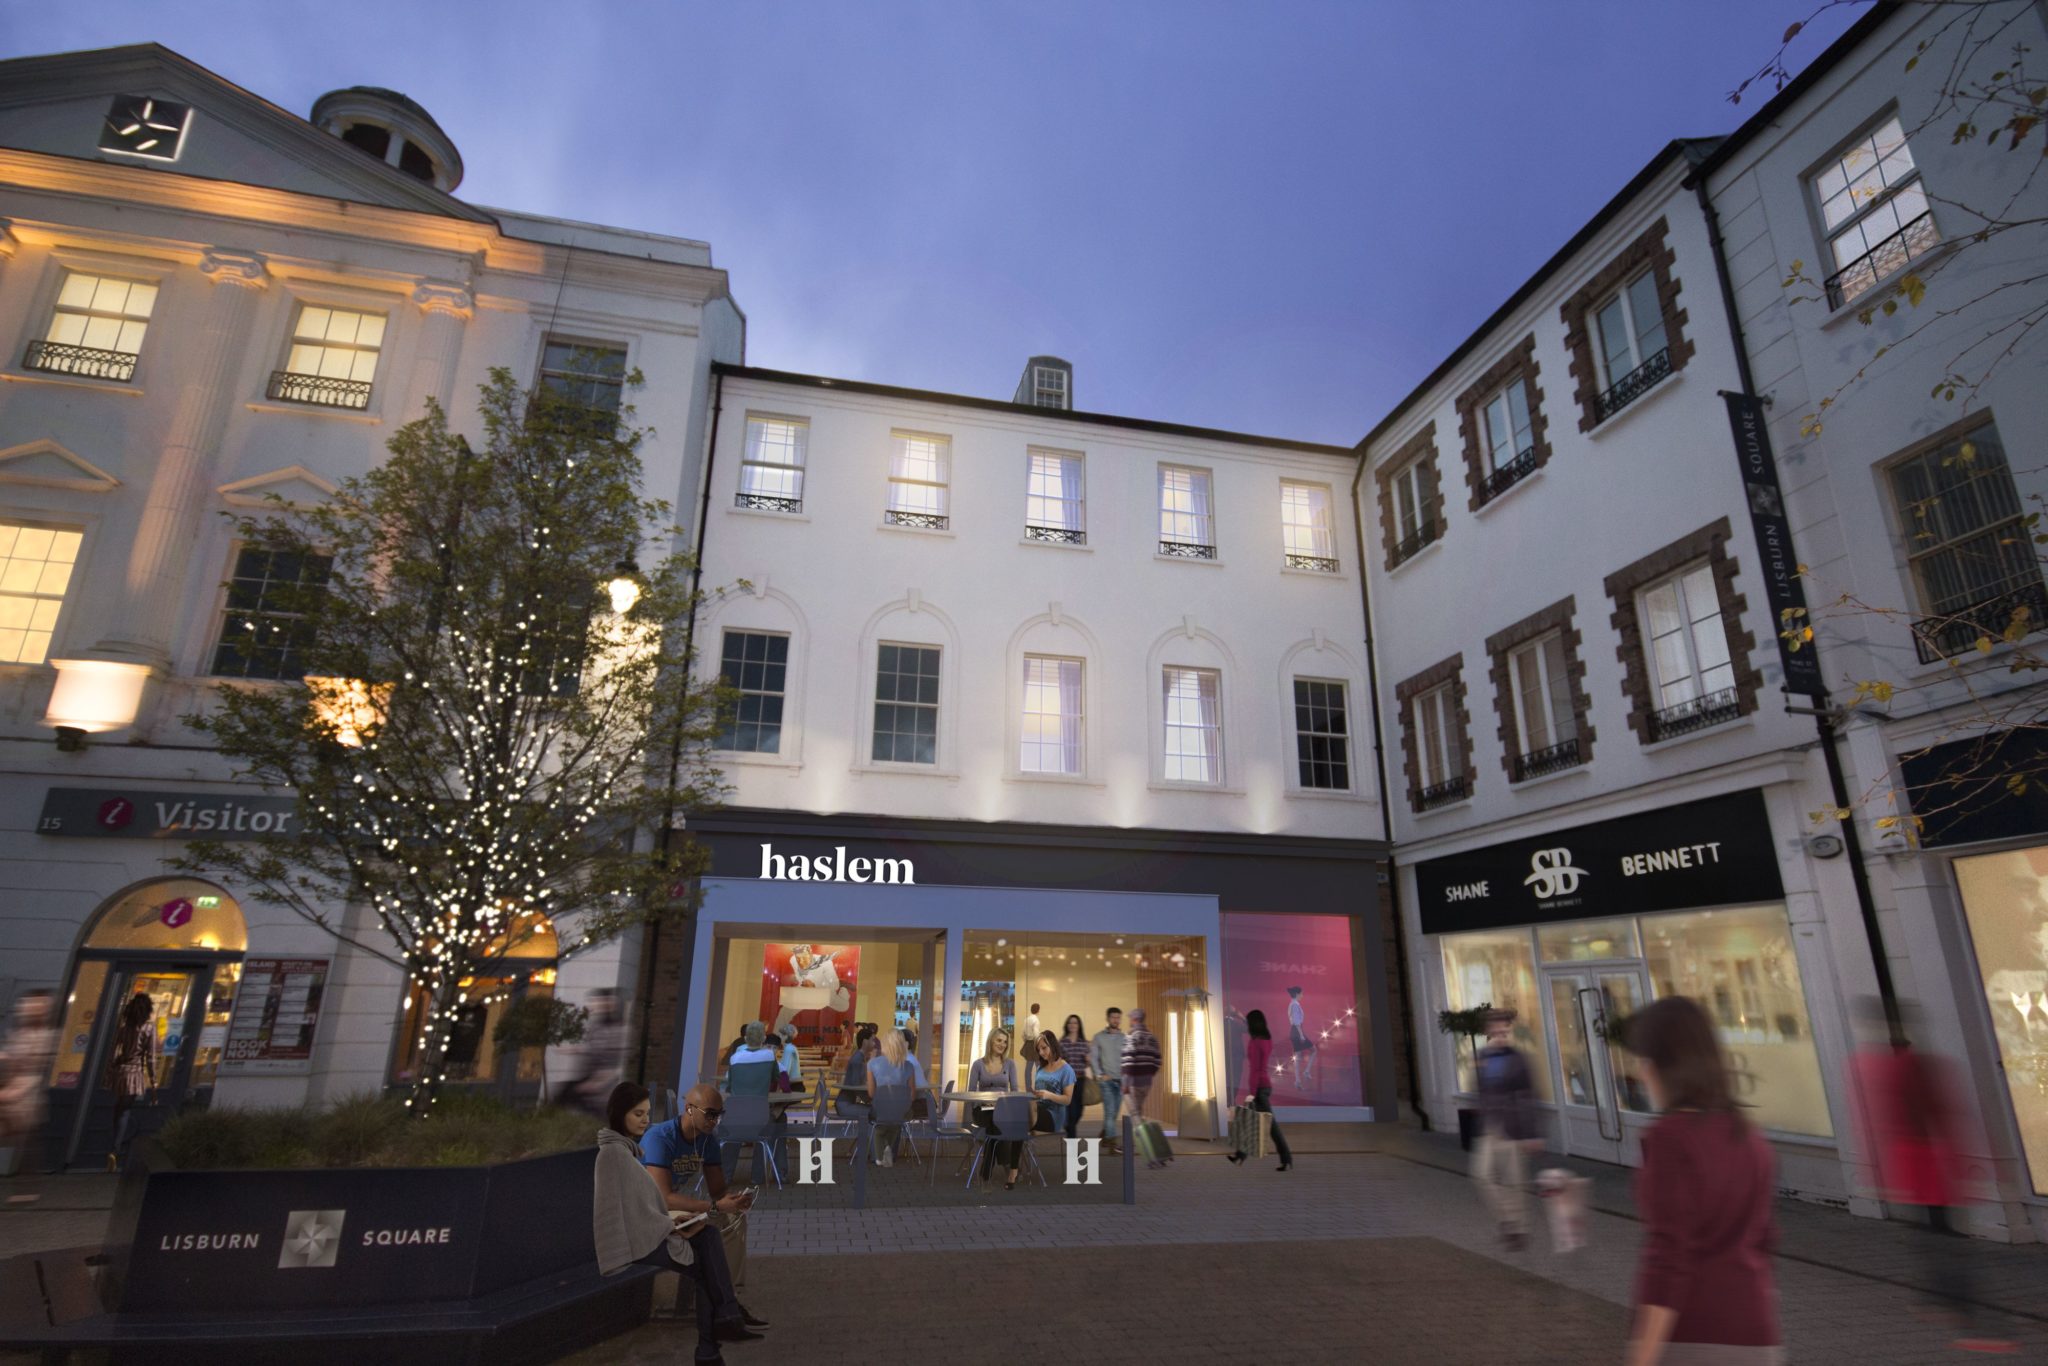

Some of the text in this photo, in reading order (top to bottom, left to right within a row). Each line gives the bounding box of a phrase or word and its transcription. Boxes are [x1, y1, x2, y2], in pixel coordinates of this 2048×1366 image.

[1742, 410, 1791, 598] LISBURN SQUARE
[40, 817, 62, 830] 15
[154, 802, 293, 833] Visitor
[759, 843, 916, 885] haslem
[1445, 842, 1721, 902] SHANE BENNETT
[226, 1049, 260, 1059] NOW
[229, 1040, 268, 1049] BOOK
[160, 1228, 452, 1252] LISBURN SQUARE
